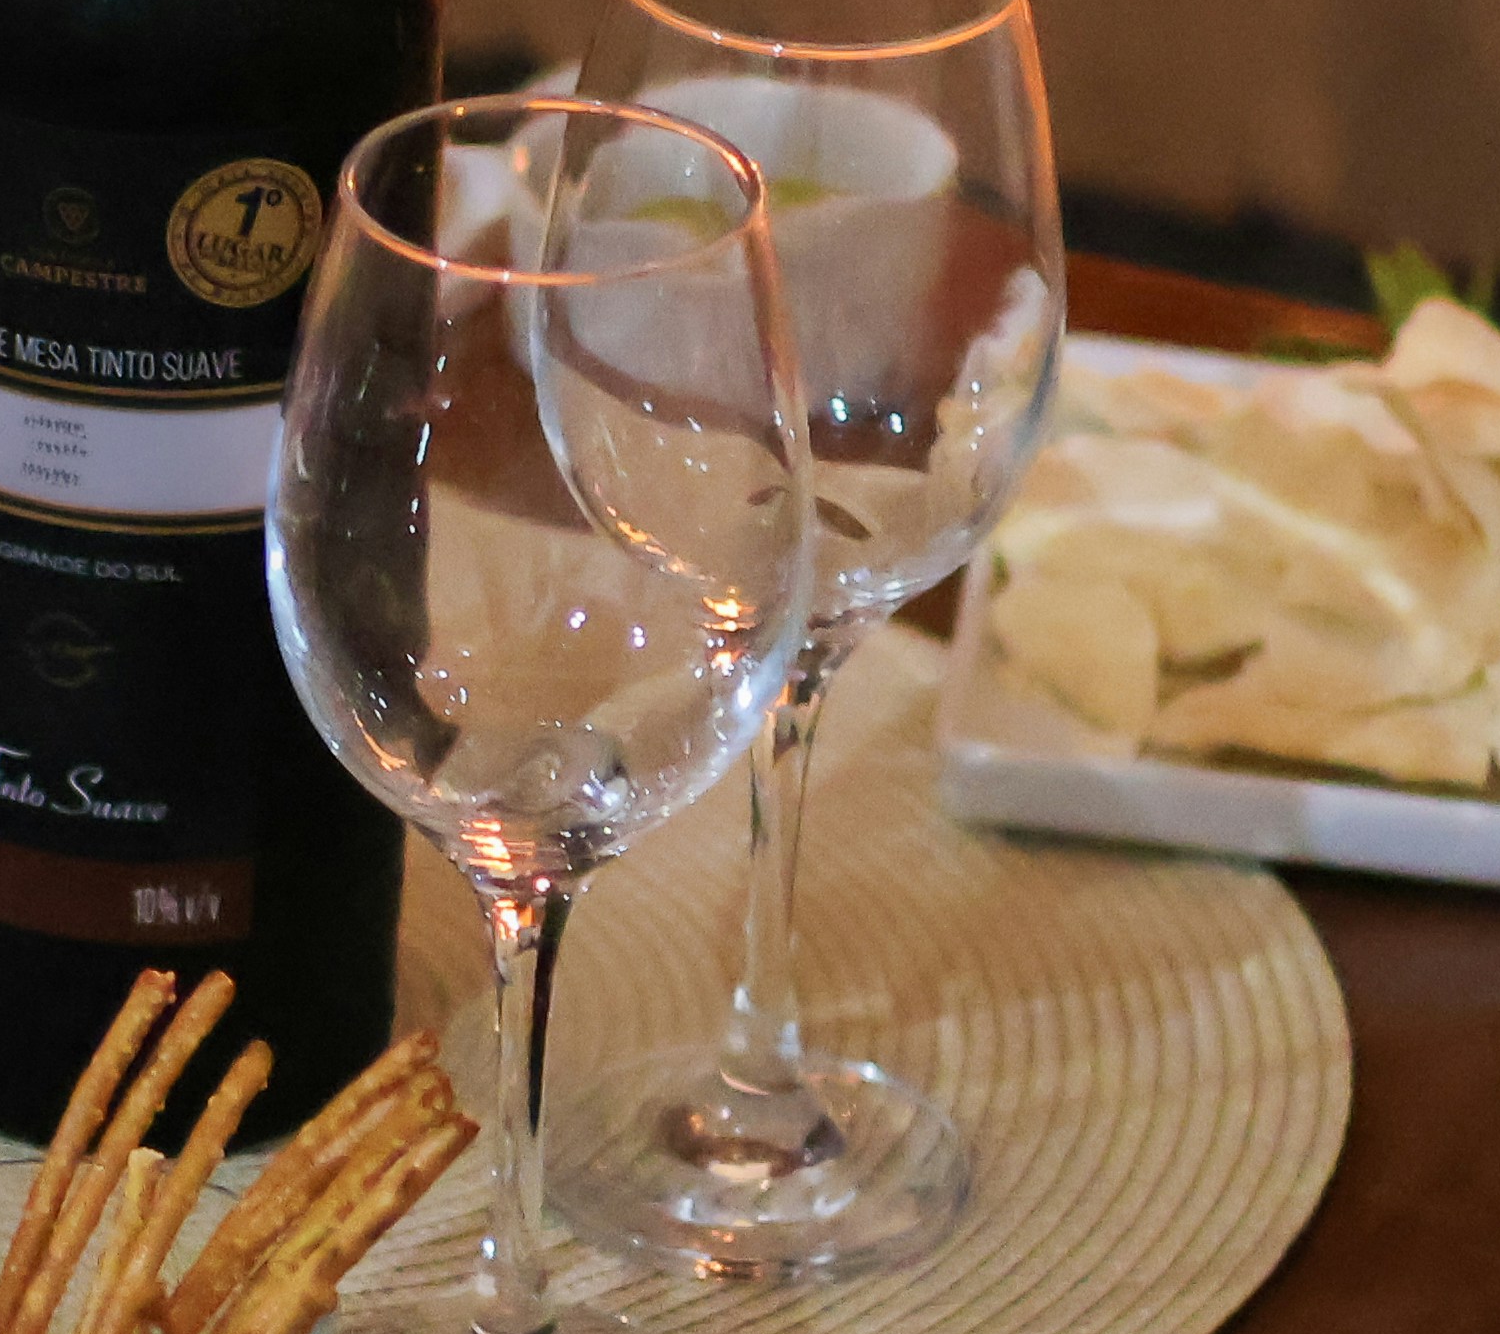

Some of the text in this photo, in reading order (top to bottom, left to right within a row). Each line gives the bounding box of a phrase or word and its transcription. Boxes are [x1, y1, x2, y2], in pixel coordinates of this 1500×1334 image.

[15, 332, 79, 373] MESA
[87, 346, 156, 380] TINTO
[160, 348, 244, 381] SUAVE
[95, 561, 131, 579] DO
[134, 563, 183, 582] SUL
[50, 763, 169, 822] Suave
